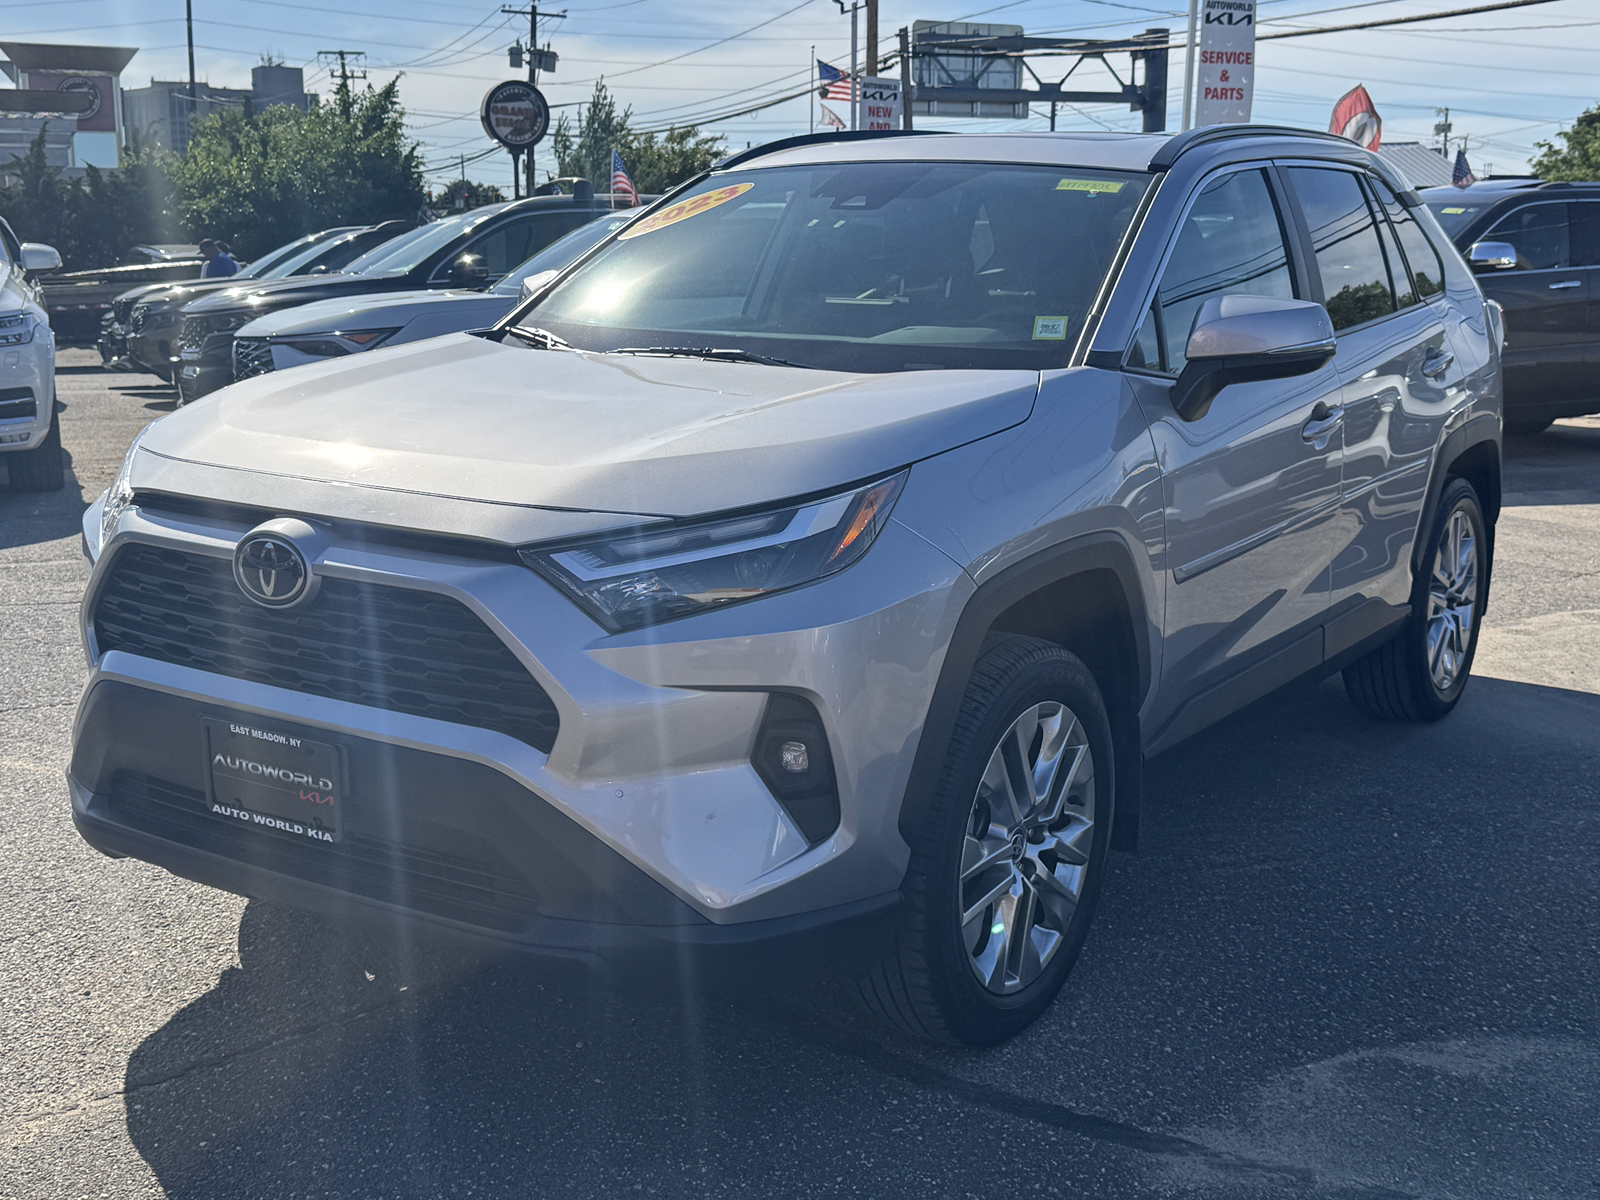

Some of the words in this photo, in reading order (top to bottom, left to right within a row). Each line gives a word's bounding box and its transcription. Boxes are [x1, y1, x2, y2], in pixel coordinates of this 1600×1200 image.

[1206, 1, 1253, 12] AUTOWORLD
[1205, 12, 1252, 26] KIA
[1201, 50, 1252, 65] SERVICE
[1219, 69, 1230, 82] &
[863, 90, 898, 101] KIA
[1204, 87, 1244, 101] PARTS
[491, 105, 535, 118] GRAND
[868, 106, 892, 118] NEW
[230, 724, 250, 736] EAST
[289, 737, 302, 748] NY
[213, 753, 333, 791] AUTOWORLD
[299, 789, 335, 806] KIA
[212, 804, 250, 821] AUTO
[252, 813, 304, 835] WORLD
[307, 828, 334, 843] KIA
